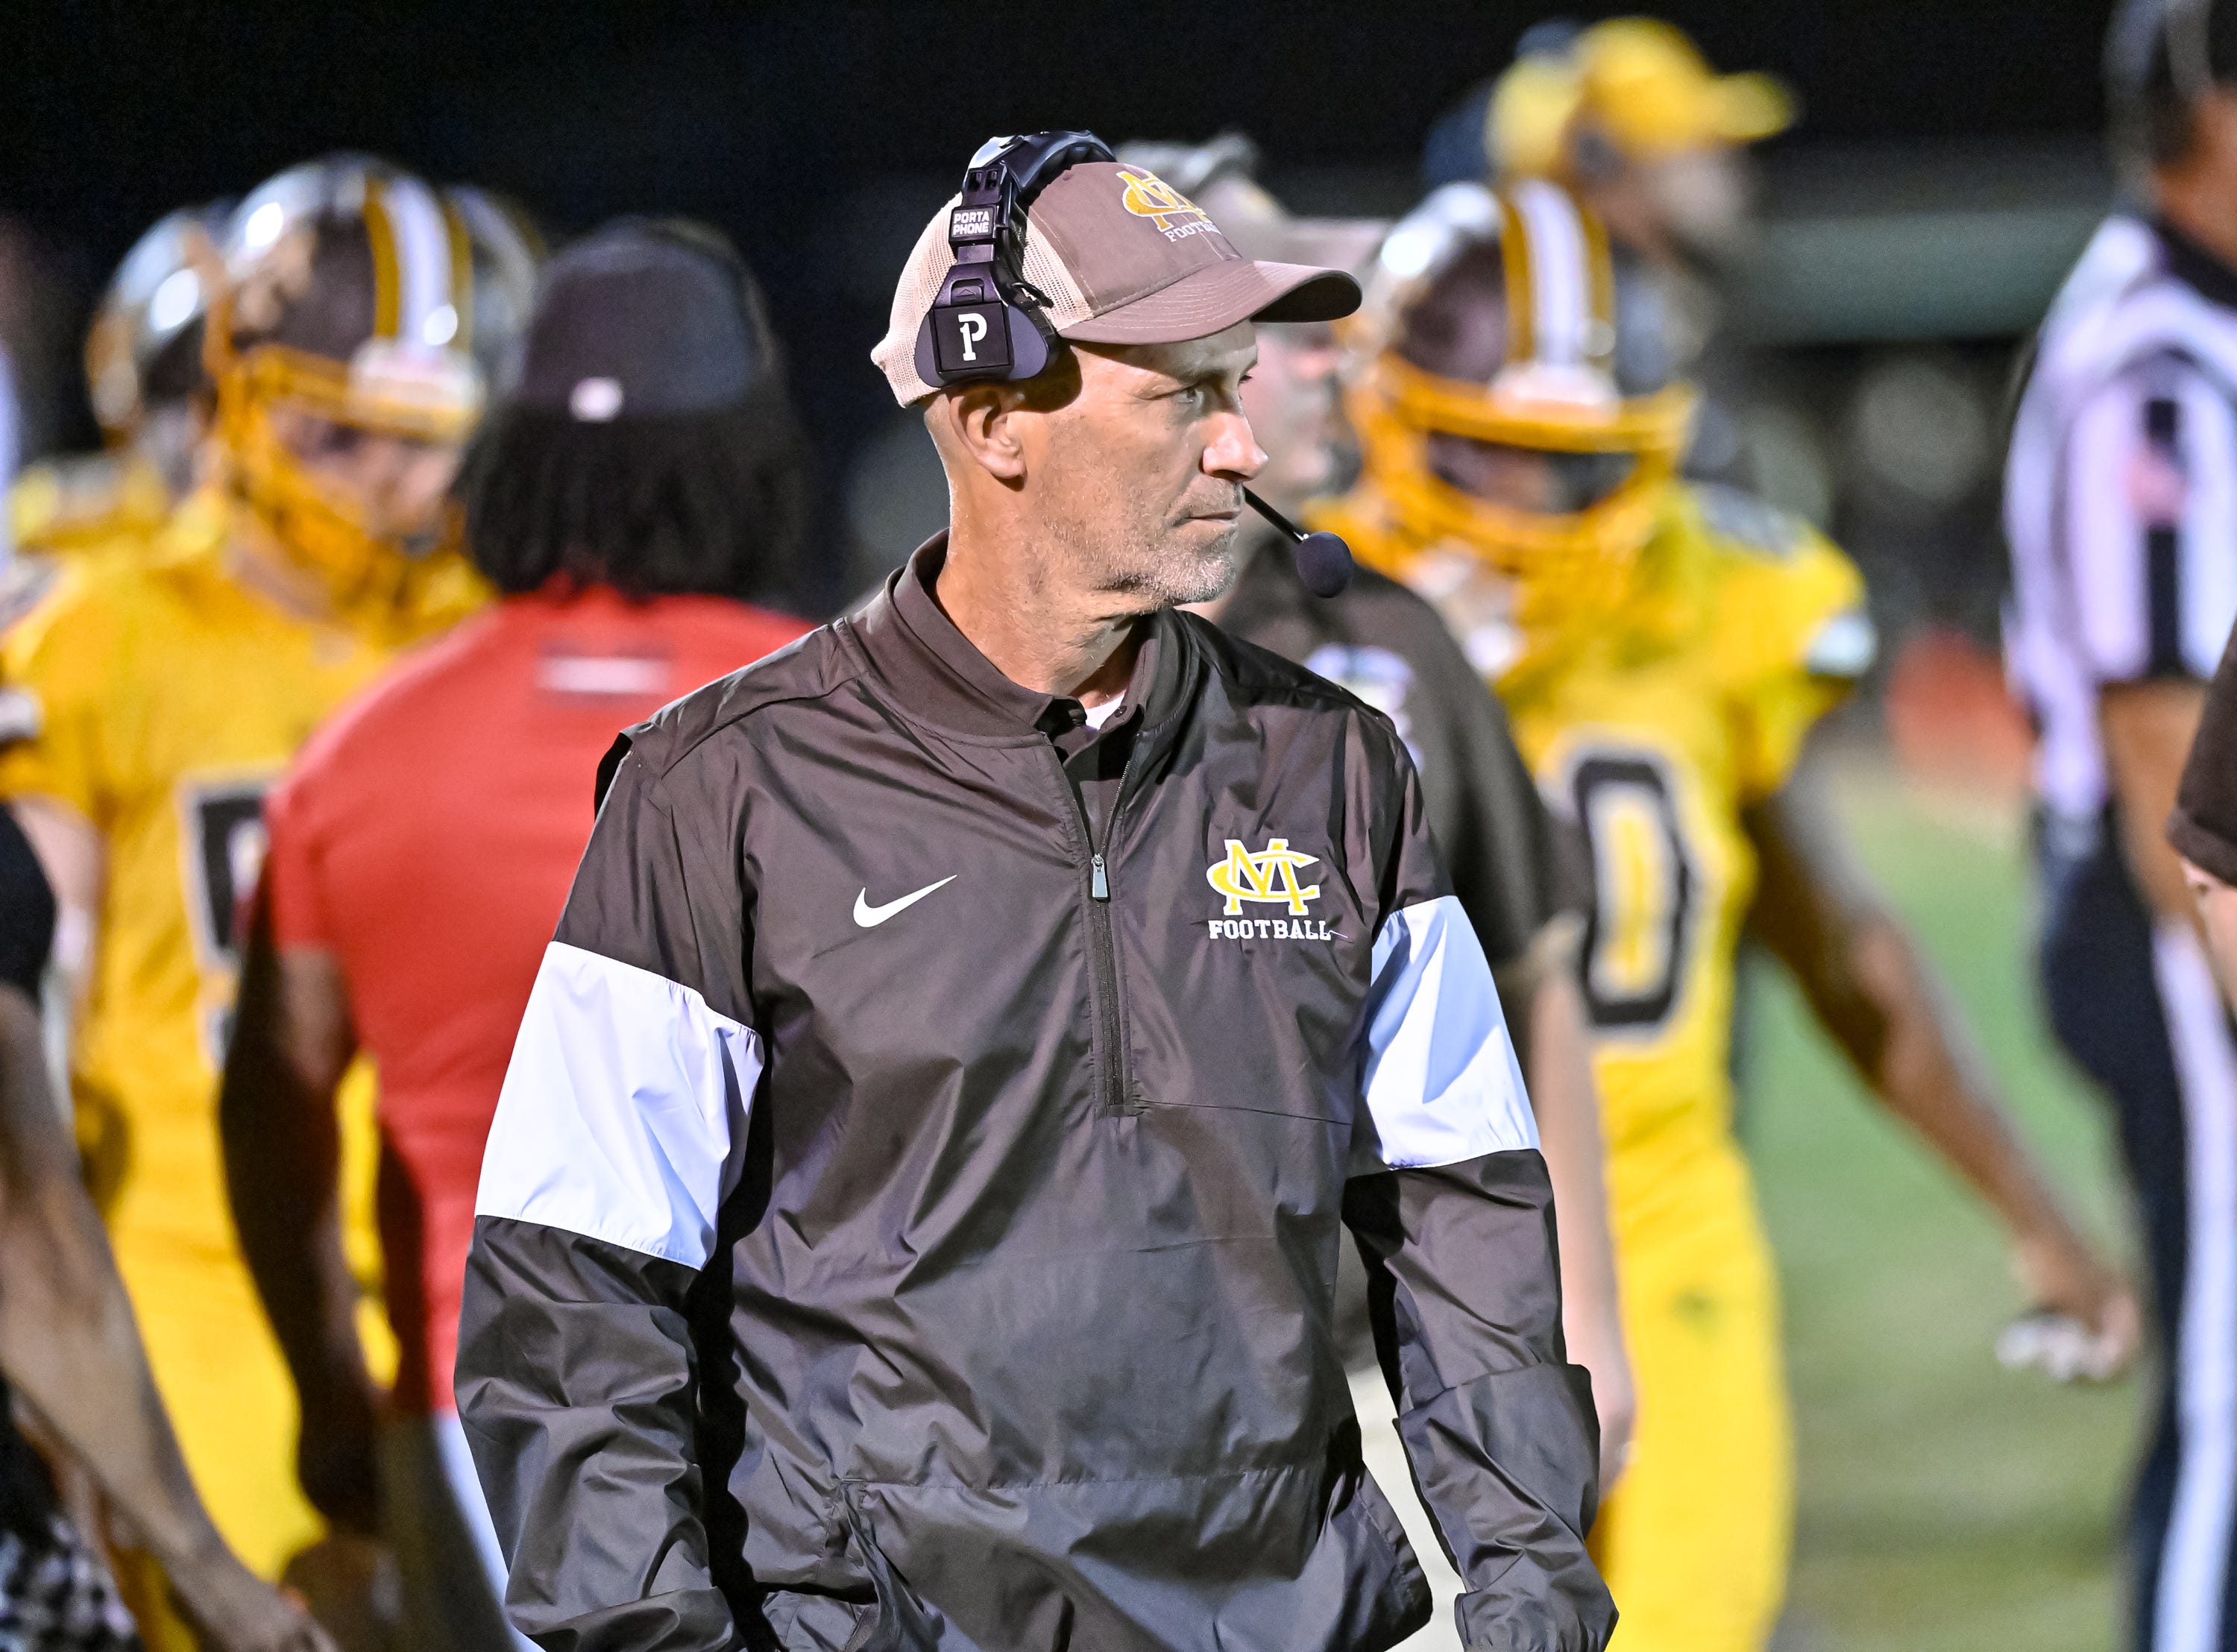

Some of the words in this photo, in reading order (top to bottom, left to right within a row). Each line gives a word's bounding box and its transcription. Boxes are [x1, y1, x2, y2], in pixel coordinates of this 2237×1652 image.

[954, 211, 989, 224] PORTA
[953, 222, 989, 235] PHONE
[957, 313, 987, 361] P
[1208, 919, 1331, 941] FOOTBALL
